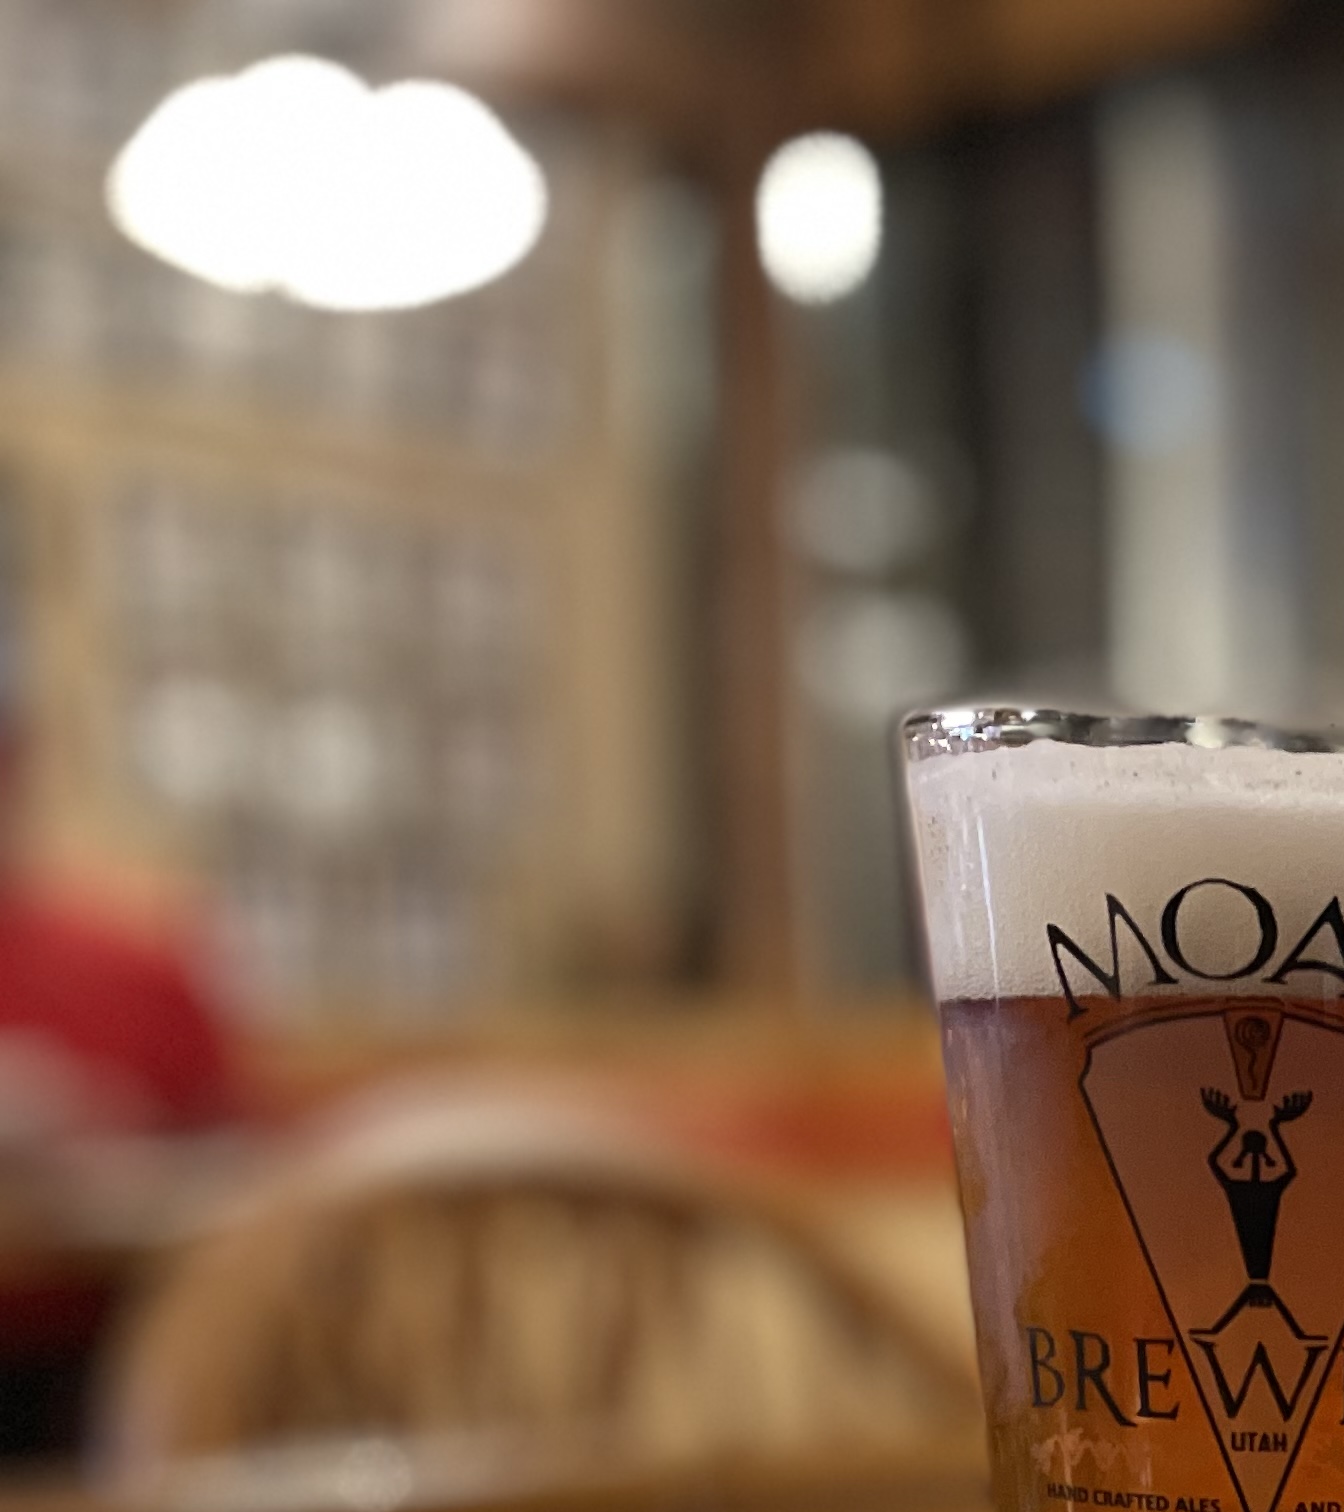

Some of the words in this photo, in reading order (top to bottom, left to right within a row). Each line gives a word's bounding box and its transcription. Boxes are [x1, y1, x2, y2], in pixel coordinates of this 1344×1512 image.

[1231, 1432, 1288, 1453] UTAH
[1047, 1483, 1089, 1503] HAND
[1093, 1489, 1170, 1512] CRAFTED
